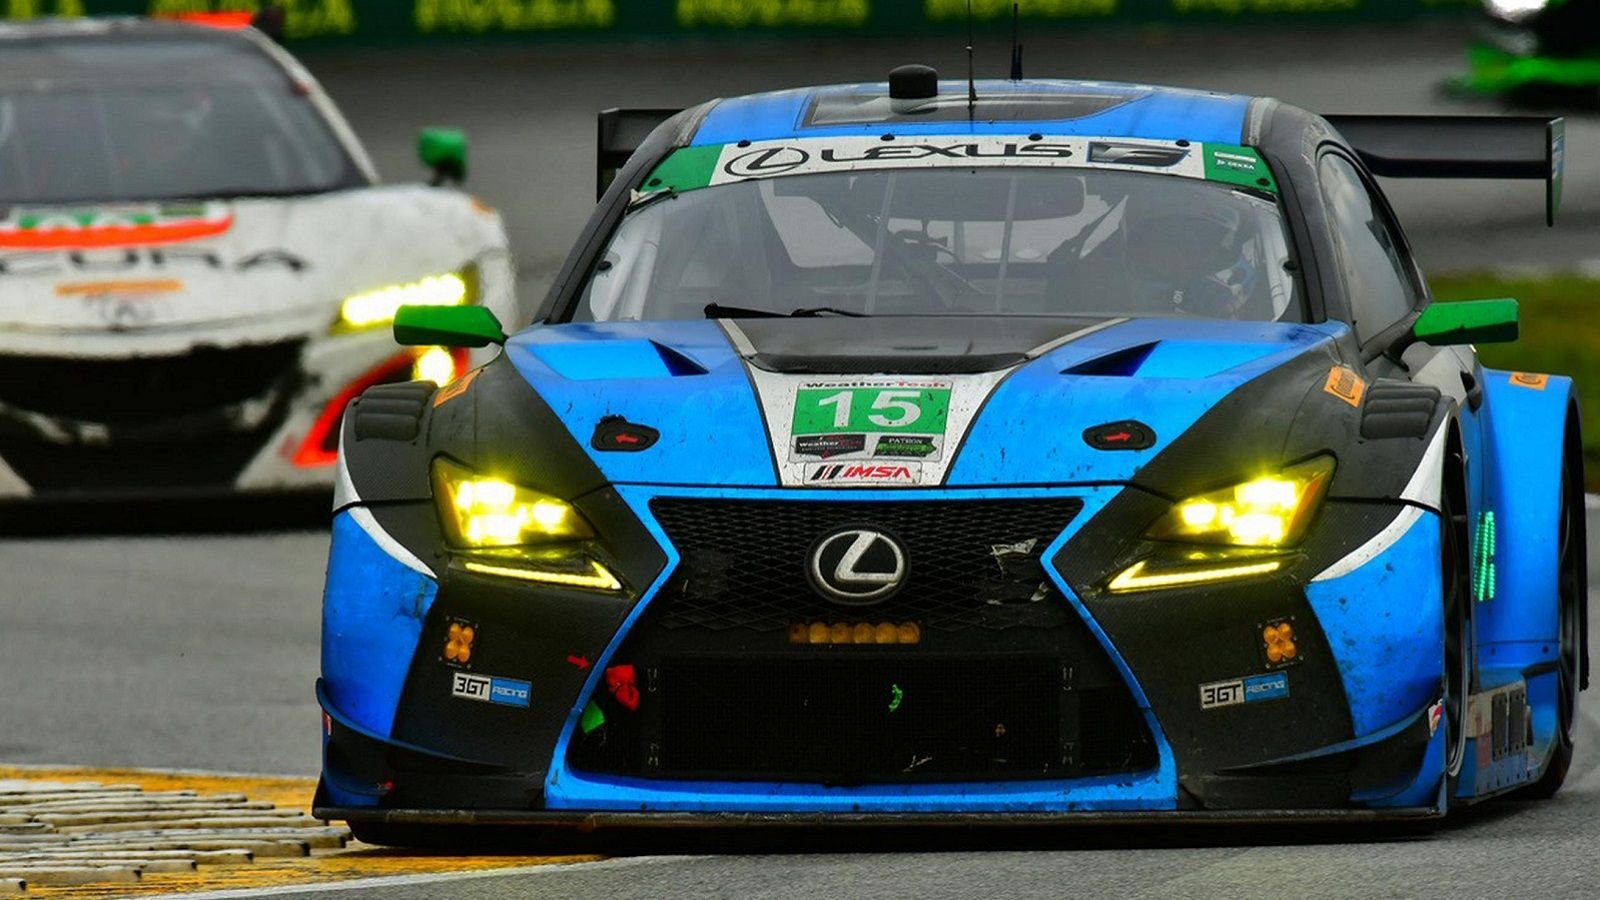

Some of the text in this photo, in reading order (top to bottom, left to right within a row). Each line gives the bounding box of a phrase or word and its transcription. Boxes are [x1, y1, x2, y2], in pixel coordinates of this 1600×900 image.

[821, 144, 1073, 162] LEXUS
[818, 391, 921, 428] 15
[842, 466, 911, 478] IMSA
[455, 676, 489, 696] 3GT
[1204, 684, 1242, 704] 3GT
